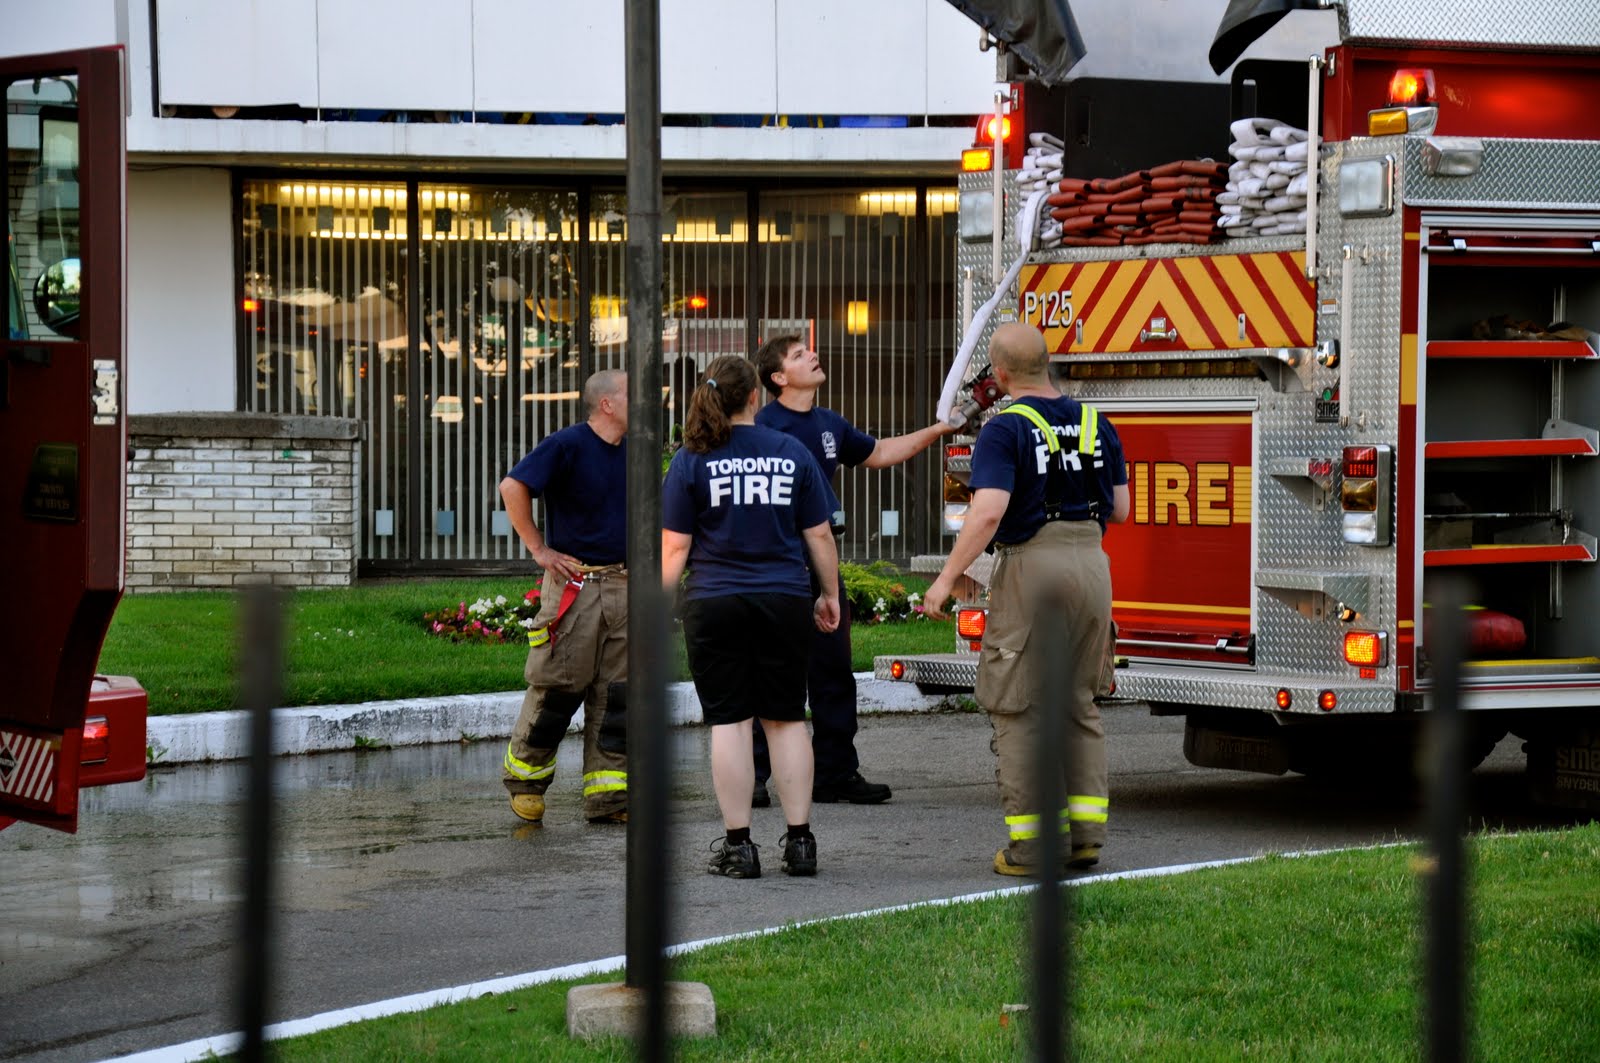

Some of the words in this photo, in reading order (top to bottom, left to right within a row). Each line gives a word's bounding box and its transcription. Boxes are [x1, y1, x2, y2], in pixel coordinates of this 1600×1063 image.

[1025, 291, 1073, 328] P125
[706, 457, 796, 477] TORONTO
[709, 474, 794, 508] FIRE
[1126, 462, 1232, 527] IRE
